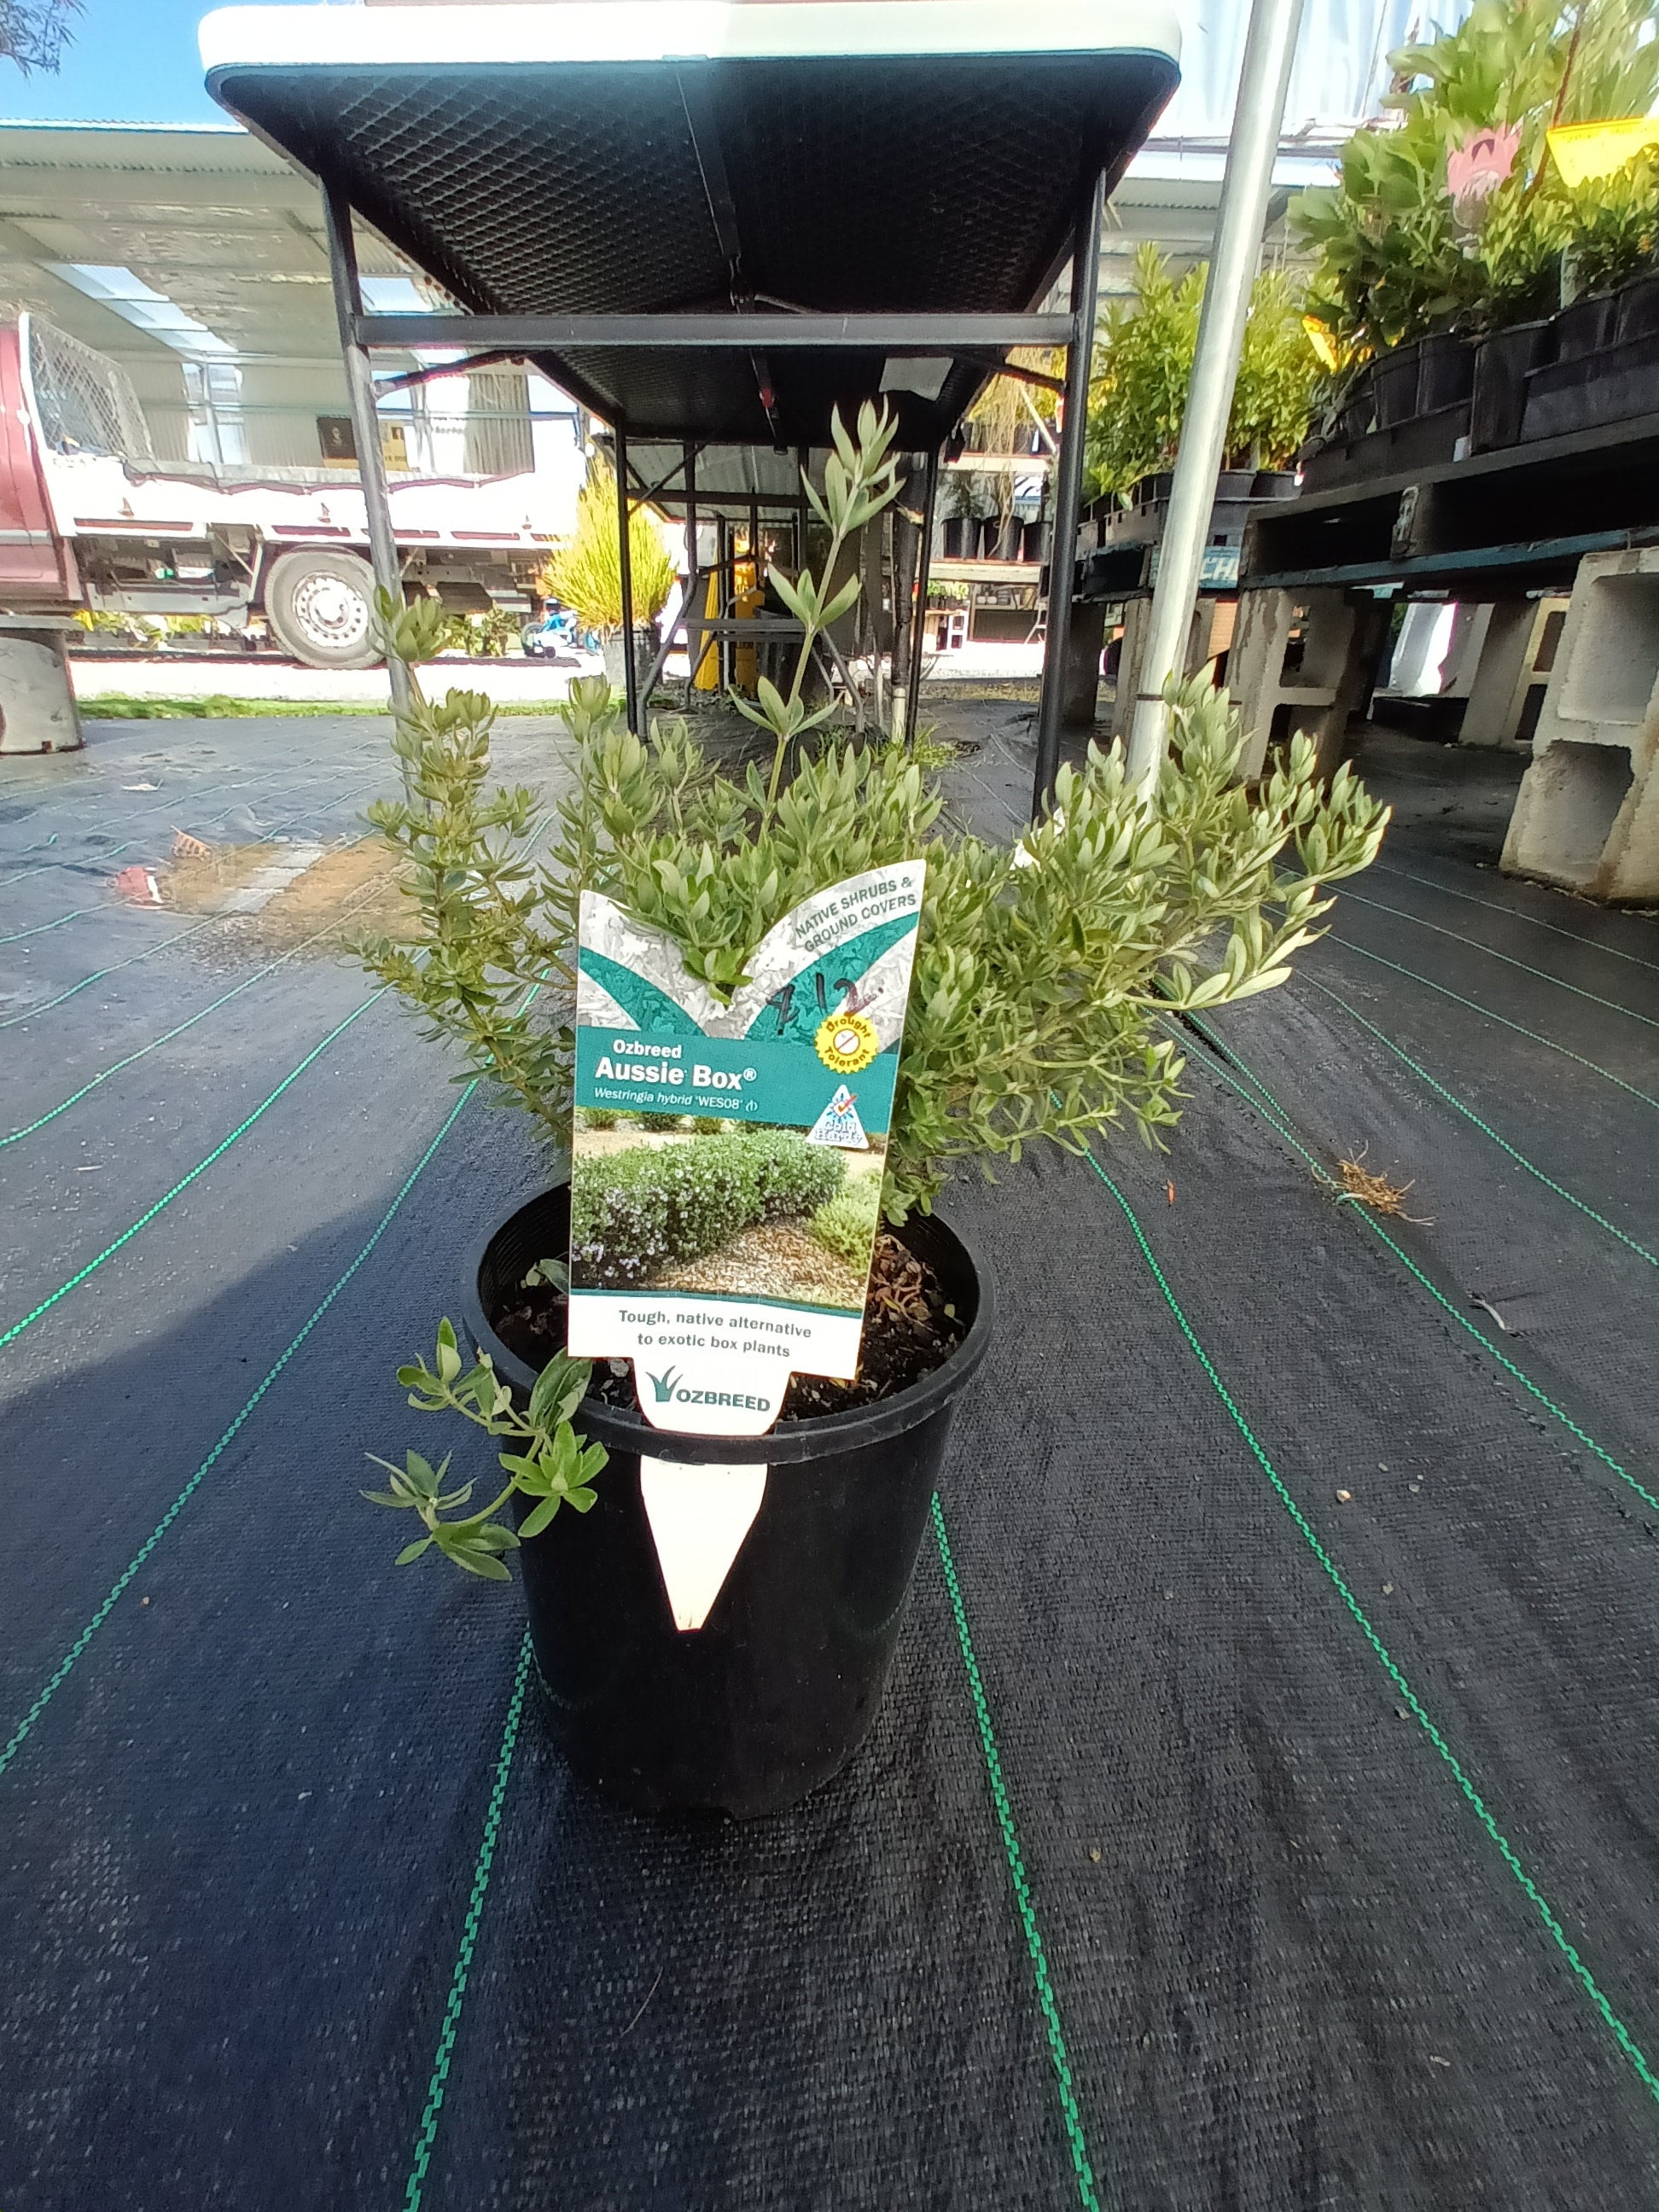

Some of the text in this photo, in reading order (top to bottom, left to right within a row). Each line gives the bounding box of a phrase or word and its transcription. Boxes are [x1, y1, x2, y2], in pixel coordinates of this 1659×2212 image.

[795, 876, 913, 939] NATIVE SHRUBS &
[804, 894, 917, 952] GROUND COVERS
[825, 1016, 872, 1039] Drought
[613, 1039, 683, 1059] Ozbreed
[824, 1046, 870, 1067] Tolerant
[595, 1057, 684, 1086] Aussie
[594, 1087, 655, 1103] Westringia
[656, 1092, 692, 1106] hybrid
[619, 1310, 812, 1338] Tough, native alternative
[637, 1333, 790, 1357] to exotic box plants
[676, 1388, 771, 1412] OZBREED
